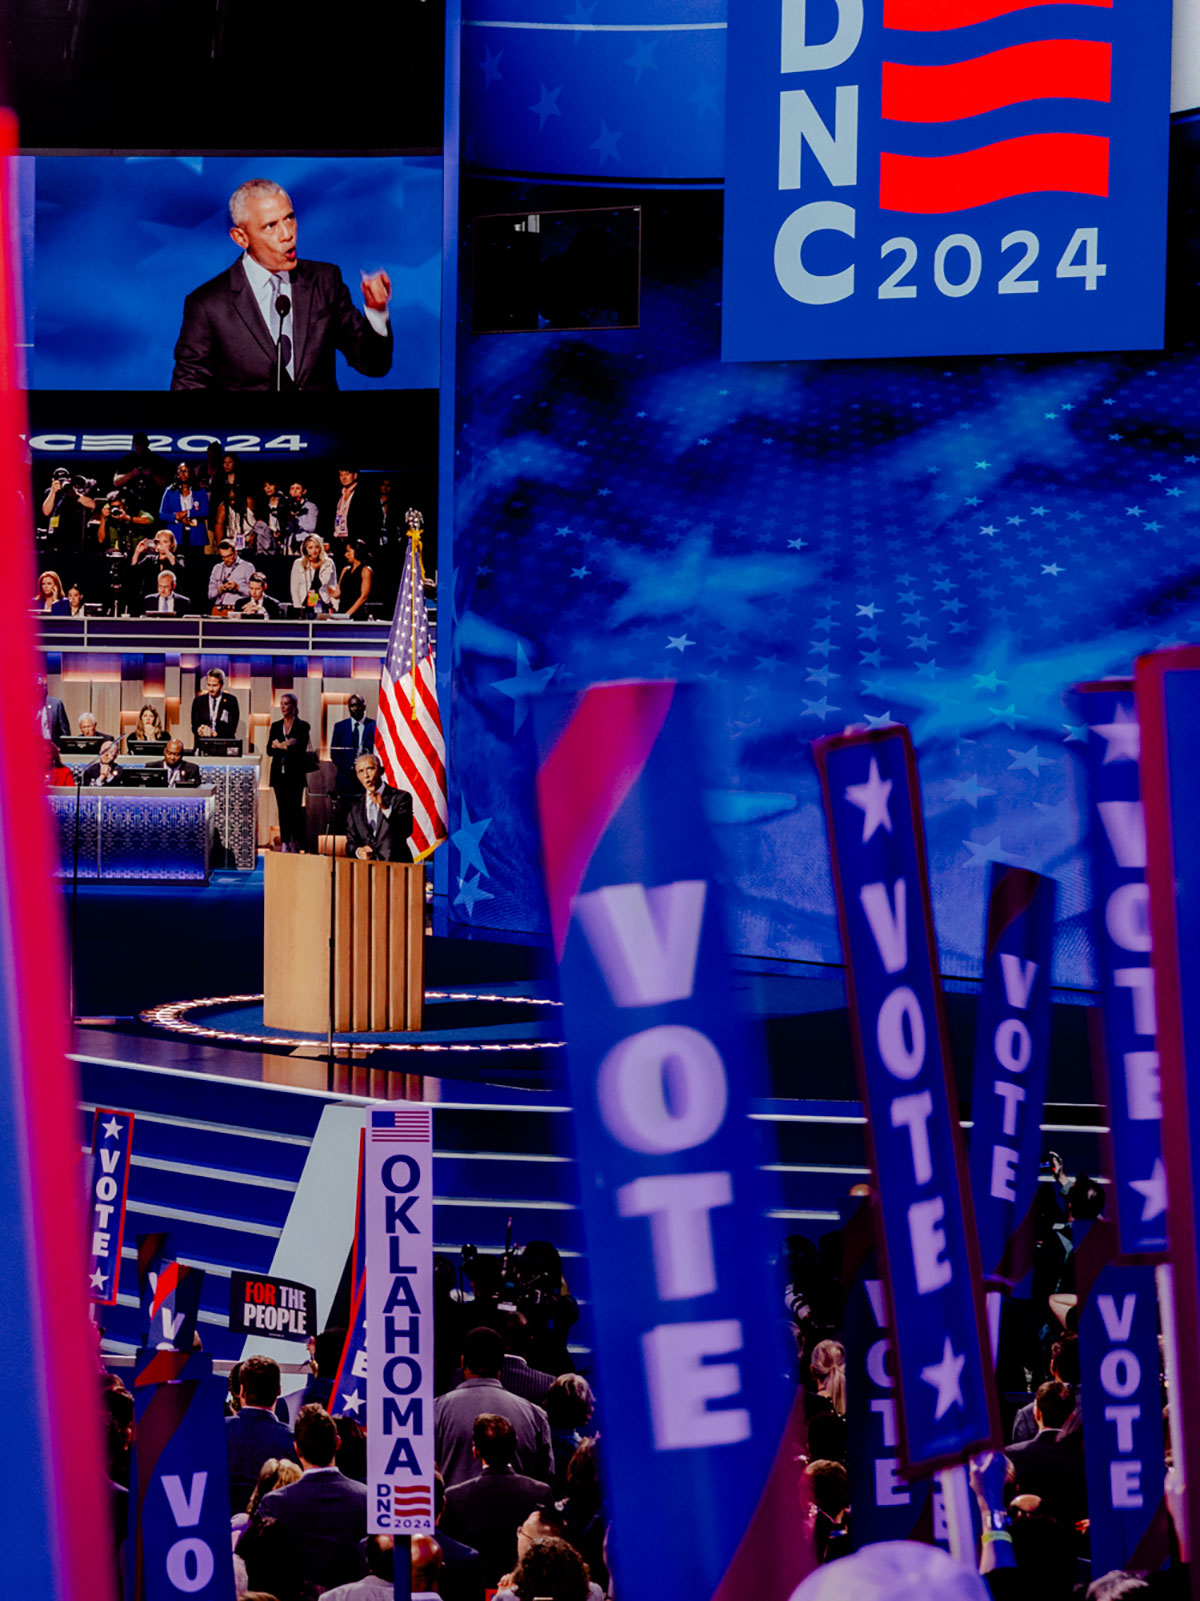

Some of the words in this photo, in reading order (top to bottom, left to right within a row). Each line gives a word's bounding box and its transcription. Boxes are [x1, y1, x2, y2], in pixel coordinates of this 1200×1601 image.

[772, 0, 864, 305] DNC
[878, 228, 1108, 300] 2024
[860, 878, 952, 1295] VOTE
[991, 953, 1038, 1202] VOTE
[91, 1148, 121, 1258] VOTE
[570, 879, 752, 1452] VOTE
[243, 1302, 307, 1335] PEOPLE
[245, 1280, 277, 1306] FOR
[279, 1285, 307, 1311] THE
[380, 1154, 423, 1476] OKLAHOMA
[1097, 1293, 1142, 1508] VOTE
[161, 1471, 215, 1594] VO
[376, 1484, 391, 1527] DNC
[394, 1519, 431, 1529] 2024
